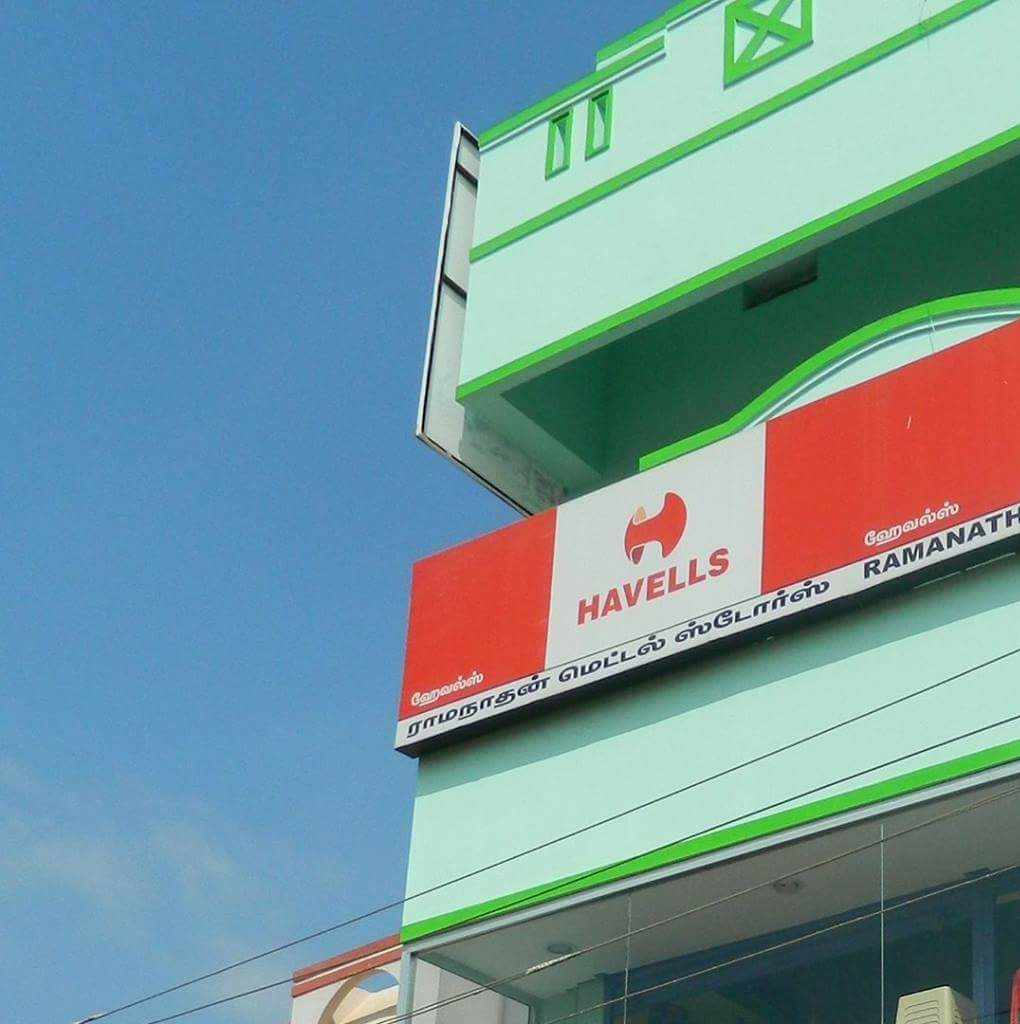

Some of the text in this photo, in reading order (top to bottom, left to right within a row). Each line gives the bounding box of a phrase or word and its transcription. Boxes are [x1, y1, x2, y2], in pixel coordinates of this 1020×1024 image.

[865, 502, 960, 547] ஹேவல்ஸ்
[577, 547, 730, 625] HAVELLS
[407, 577, 830, 738] ராமநாதன் மெட்டல் ஸ்டோர்ஸ்
[411, 670, 484, 707] ஹேவல்ஸ்
